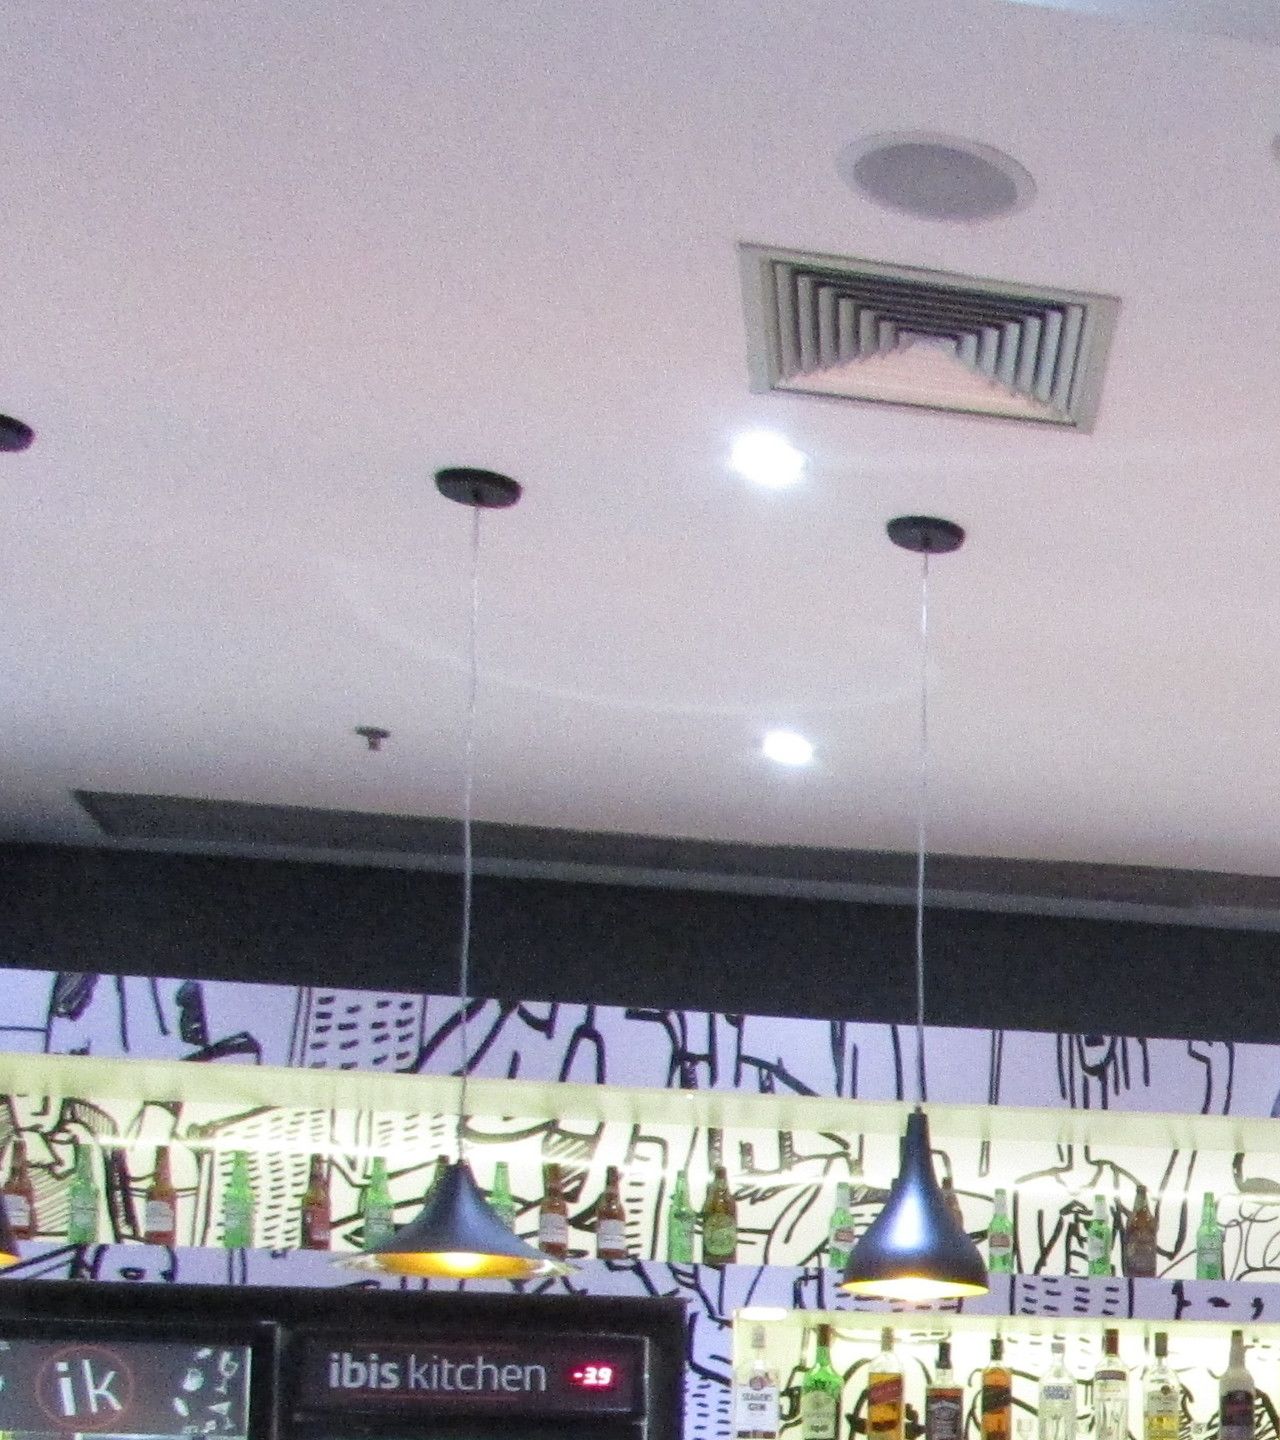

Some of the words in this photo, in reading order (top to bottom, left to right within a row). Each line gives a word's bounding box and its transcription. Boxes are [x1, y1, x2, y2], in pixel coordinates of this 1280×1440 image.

[55, 1359, 123, 1416] ik
[328, 1353, 401, 1389] ibis
[408, 1353, 547, 1391] kitchen
